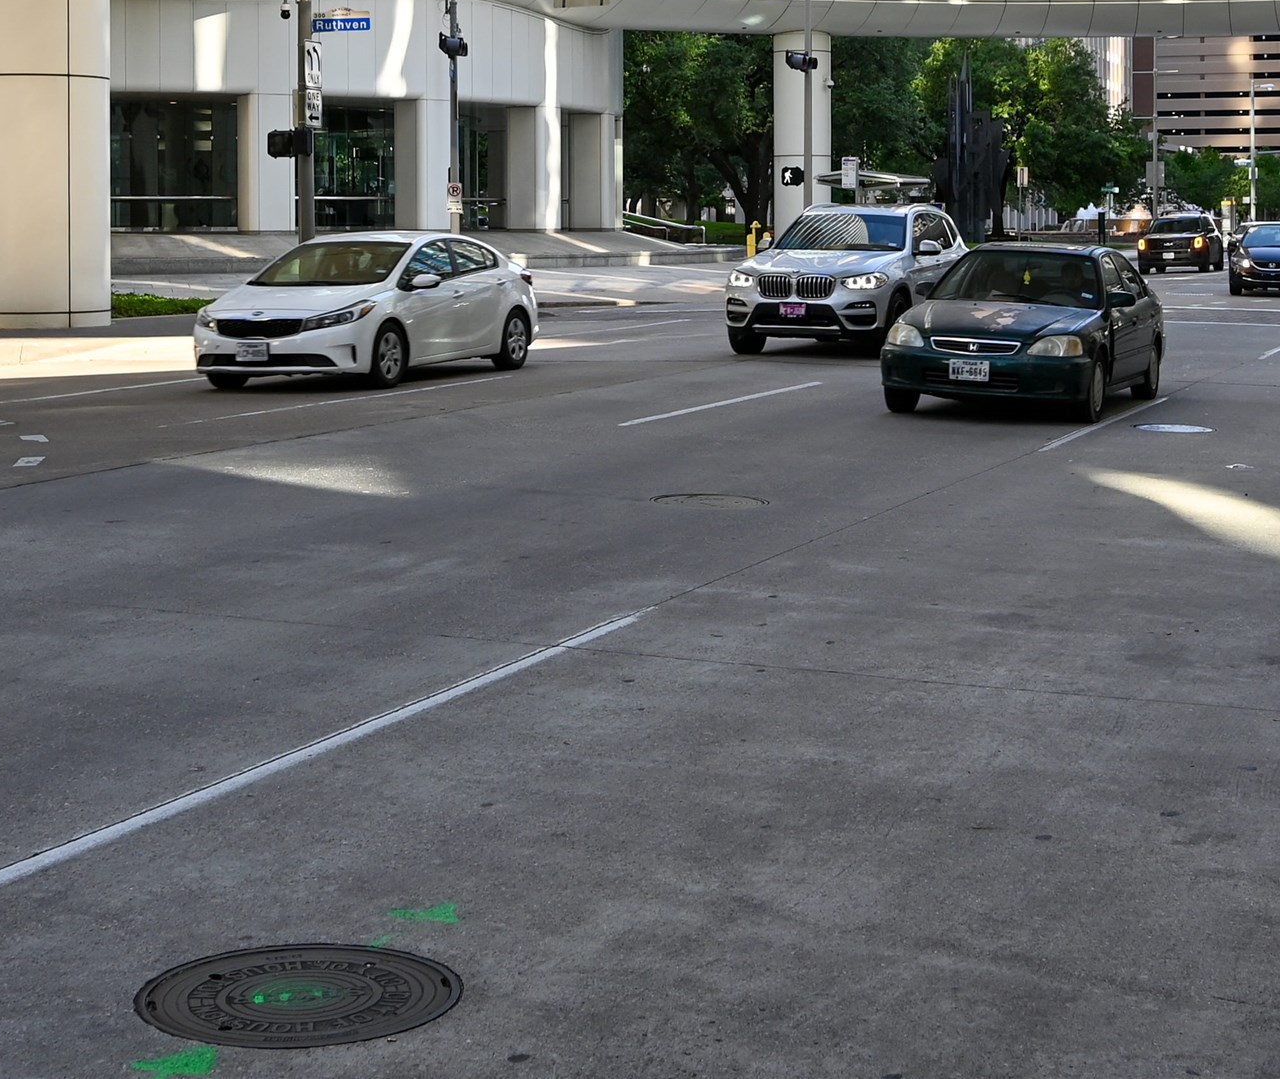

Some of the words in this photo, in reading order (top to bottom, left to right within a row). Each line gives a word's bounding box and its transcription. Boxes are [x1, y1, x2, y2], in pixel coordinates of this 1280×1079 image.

[316, 20, 367, 31] Ruthven
[307, 72, 320, 86] ONLY
[307, 91, 320, 102] ONE
[307, 102, 320, 112] WAY
